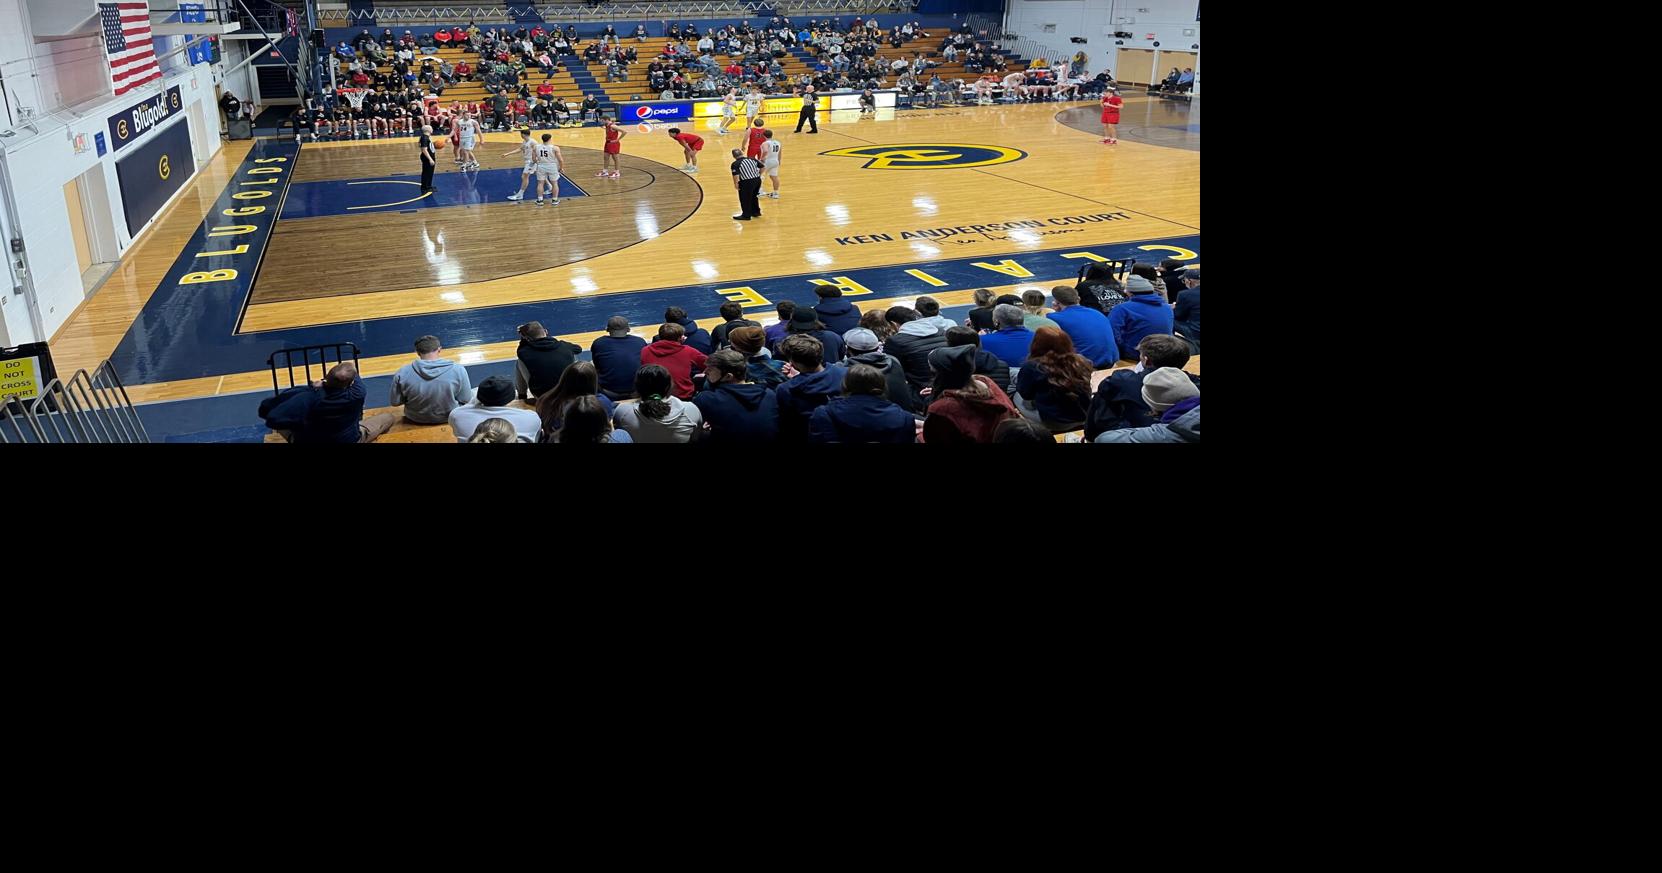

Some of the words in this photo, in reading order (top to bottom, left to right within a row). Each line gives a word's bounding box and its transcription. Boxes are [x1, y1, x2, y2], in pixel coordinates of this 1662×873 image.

[653, 107, 679, 116] pepsi
[540, 149, 549, 158] 15
[178, 157, 288, 285] BLUGOLDS
[835, 233, 894, 246] KEN
[900, 219, 1047, 240] ANDERSON
[1048, 211, 1132, 226] COURT
[5, 361, 21, 369] DO
[3, 370, 25, 379] NOT
[1, 381, 32, 390] CROSS
